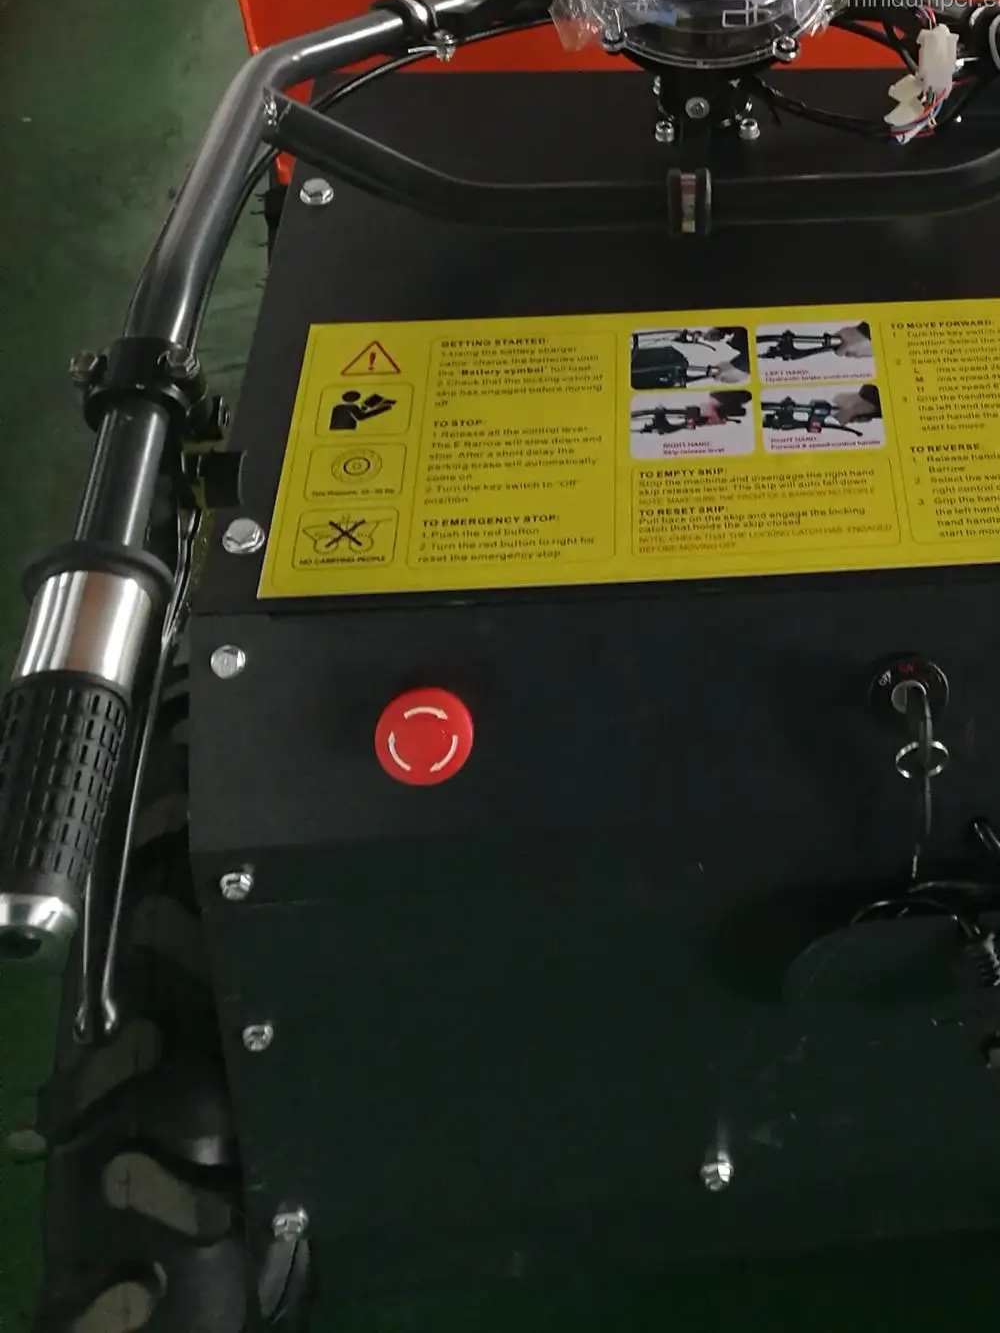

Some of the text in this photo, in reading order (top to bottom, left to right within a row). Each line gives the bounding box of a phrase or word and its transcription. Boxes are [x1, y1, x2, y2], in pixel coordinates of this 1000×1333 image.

[433, 419, 448, 428] TO
[910, 444, 924, 453] TO
[639, 470, 653, 478] TO
[639, 508, 654, 516] TO
[422, 519, 438, 528] TO
[441, 515, 520, 527] EMERGENCY
